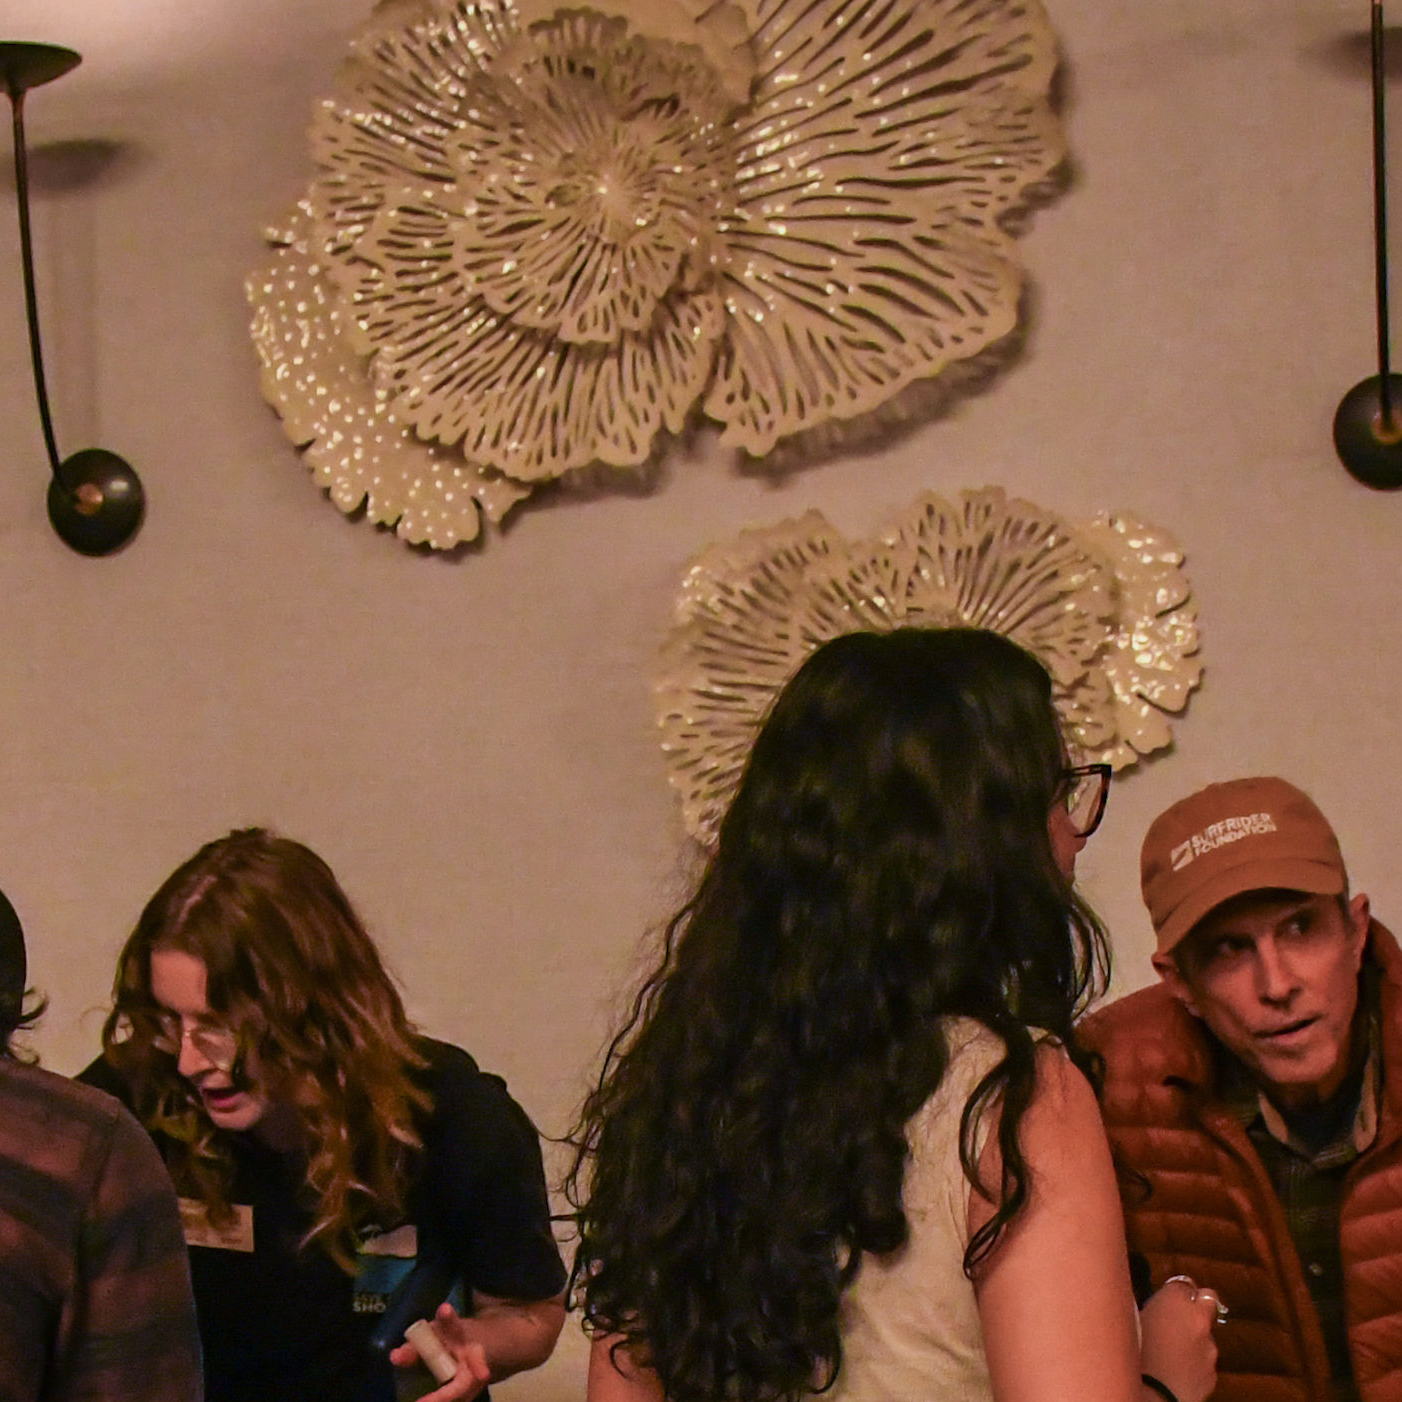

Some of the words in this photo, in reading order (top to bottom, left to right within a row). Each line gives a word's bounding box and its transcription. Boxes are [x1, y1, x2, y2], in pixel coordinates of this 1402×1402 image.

[1192, 813, 1270, 848] SURFRIDER
[1195, 820, 1277, 856] FOUNDATION
[352, 1301, 387, 1312] SHO
